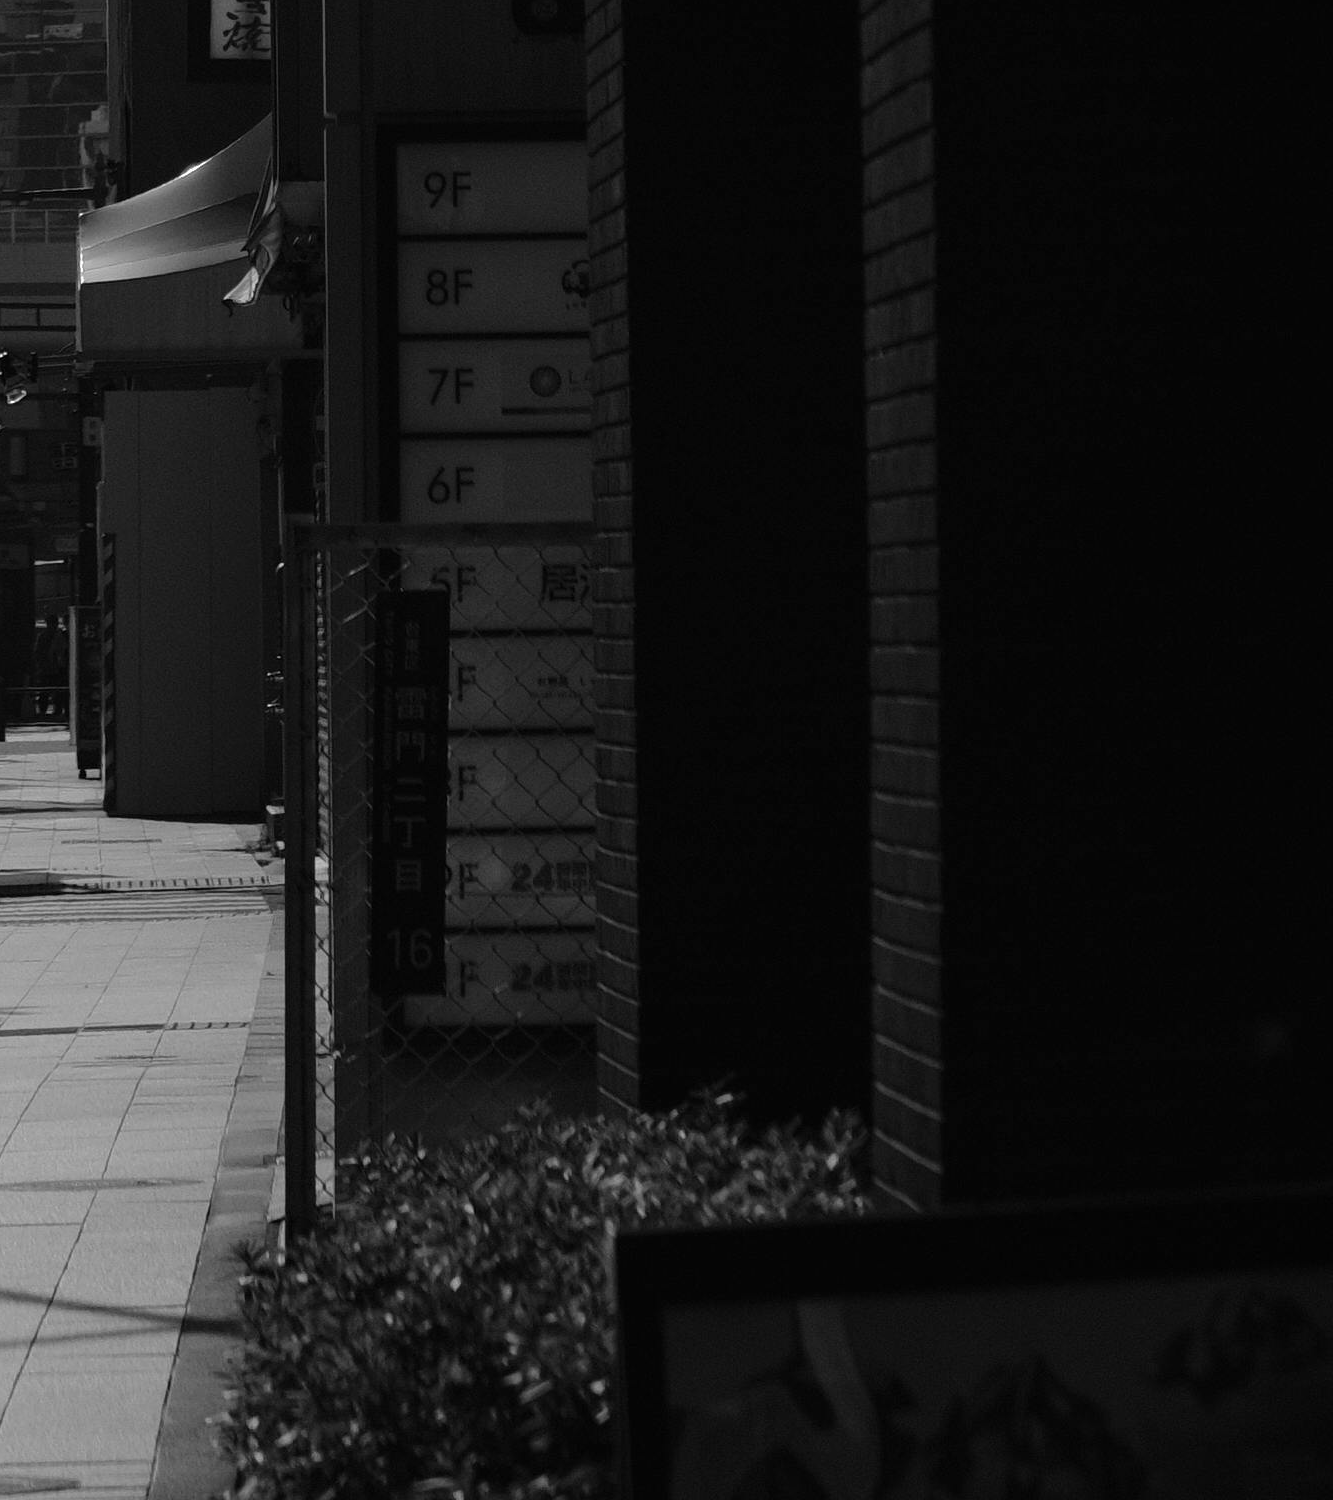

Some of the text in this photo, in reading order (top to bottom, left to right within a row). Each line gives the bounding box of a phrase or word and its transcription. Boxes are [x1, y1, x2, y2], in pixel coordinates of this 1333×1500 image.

[425, 172, 472, 210] 9F
[426, 269, 474, 307] 8F
[427, 368, 475, 407] 7F
[427, 466, 475, 505] 6F
[394, 686, 427, 892] 雷門二丁目
[387, 928, 433, 970] 16
